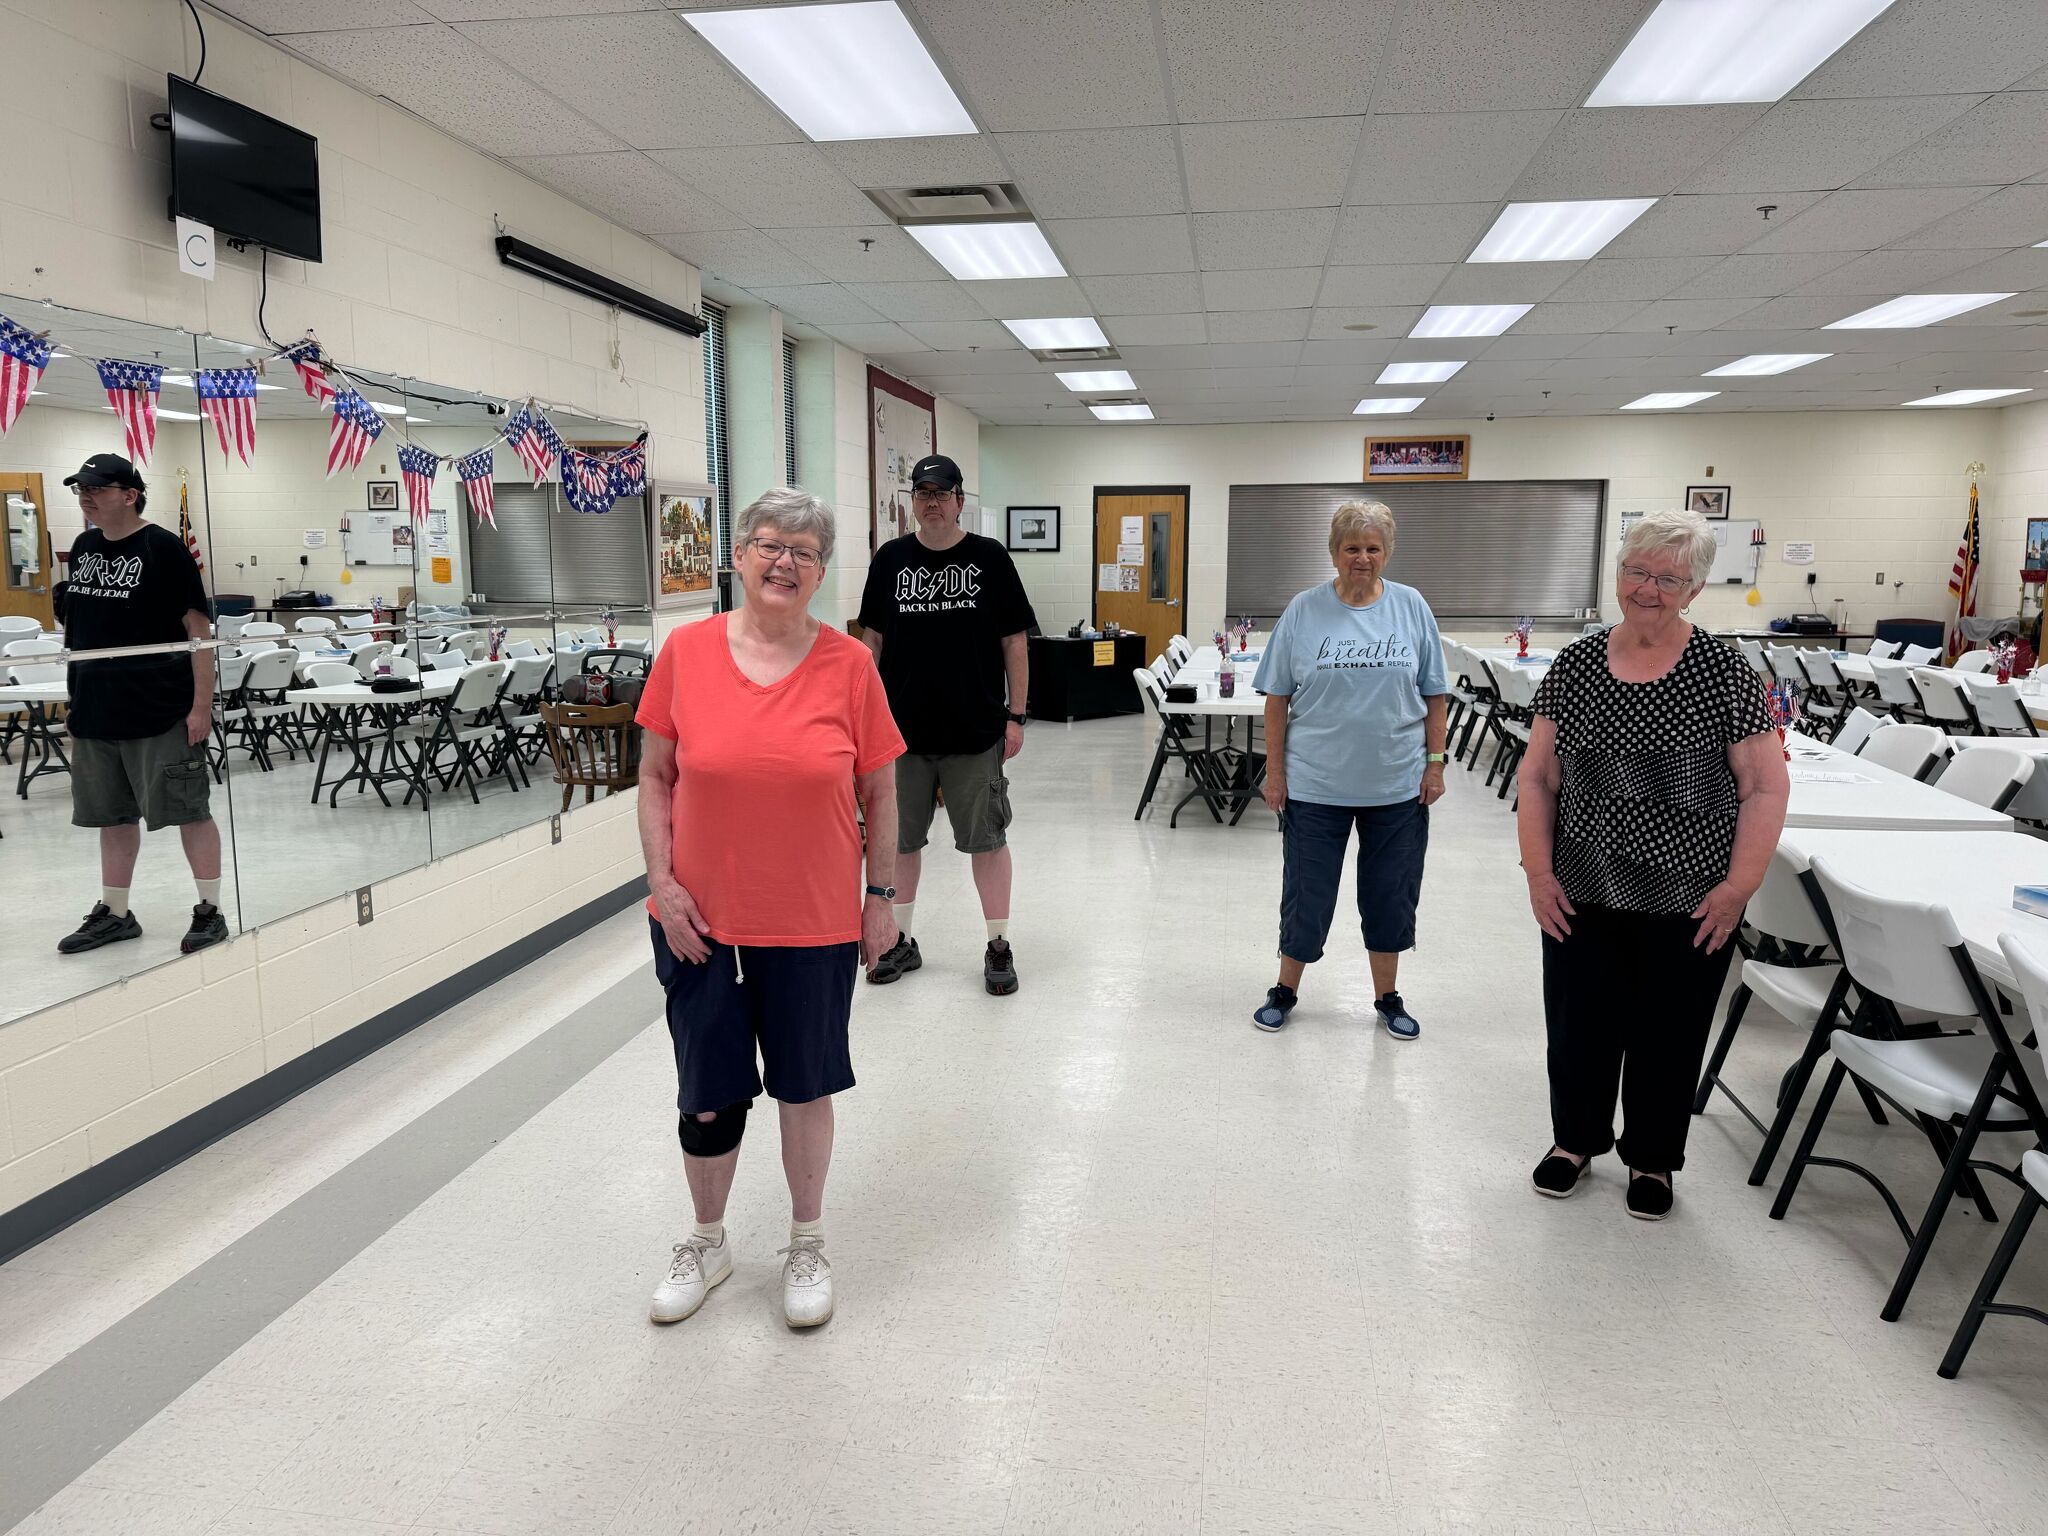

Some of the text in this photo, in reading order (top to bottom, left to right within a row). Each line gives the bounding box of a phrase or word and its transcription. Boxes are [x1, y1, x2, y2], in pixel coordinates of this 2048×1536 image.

[185, 234, 207, 267] C
[899, 599, 976, 613] BACK IN BLACK
[1316, 633, 1412, 661] breathe
[1334, 661, 1385, 669] EXHALE
[1387, 660, 1412, 668] REPEAT
